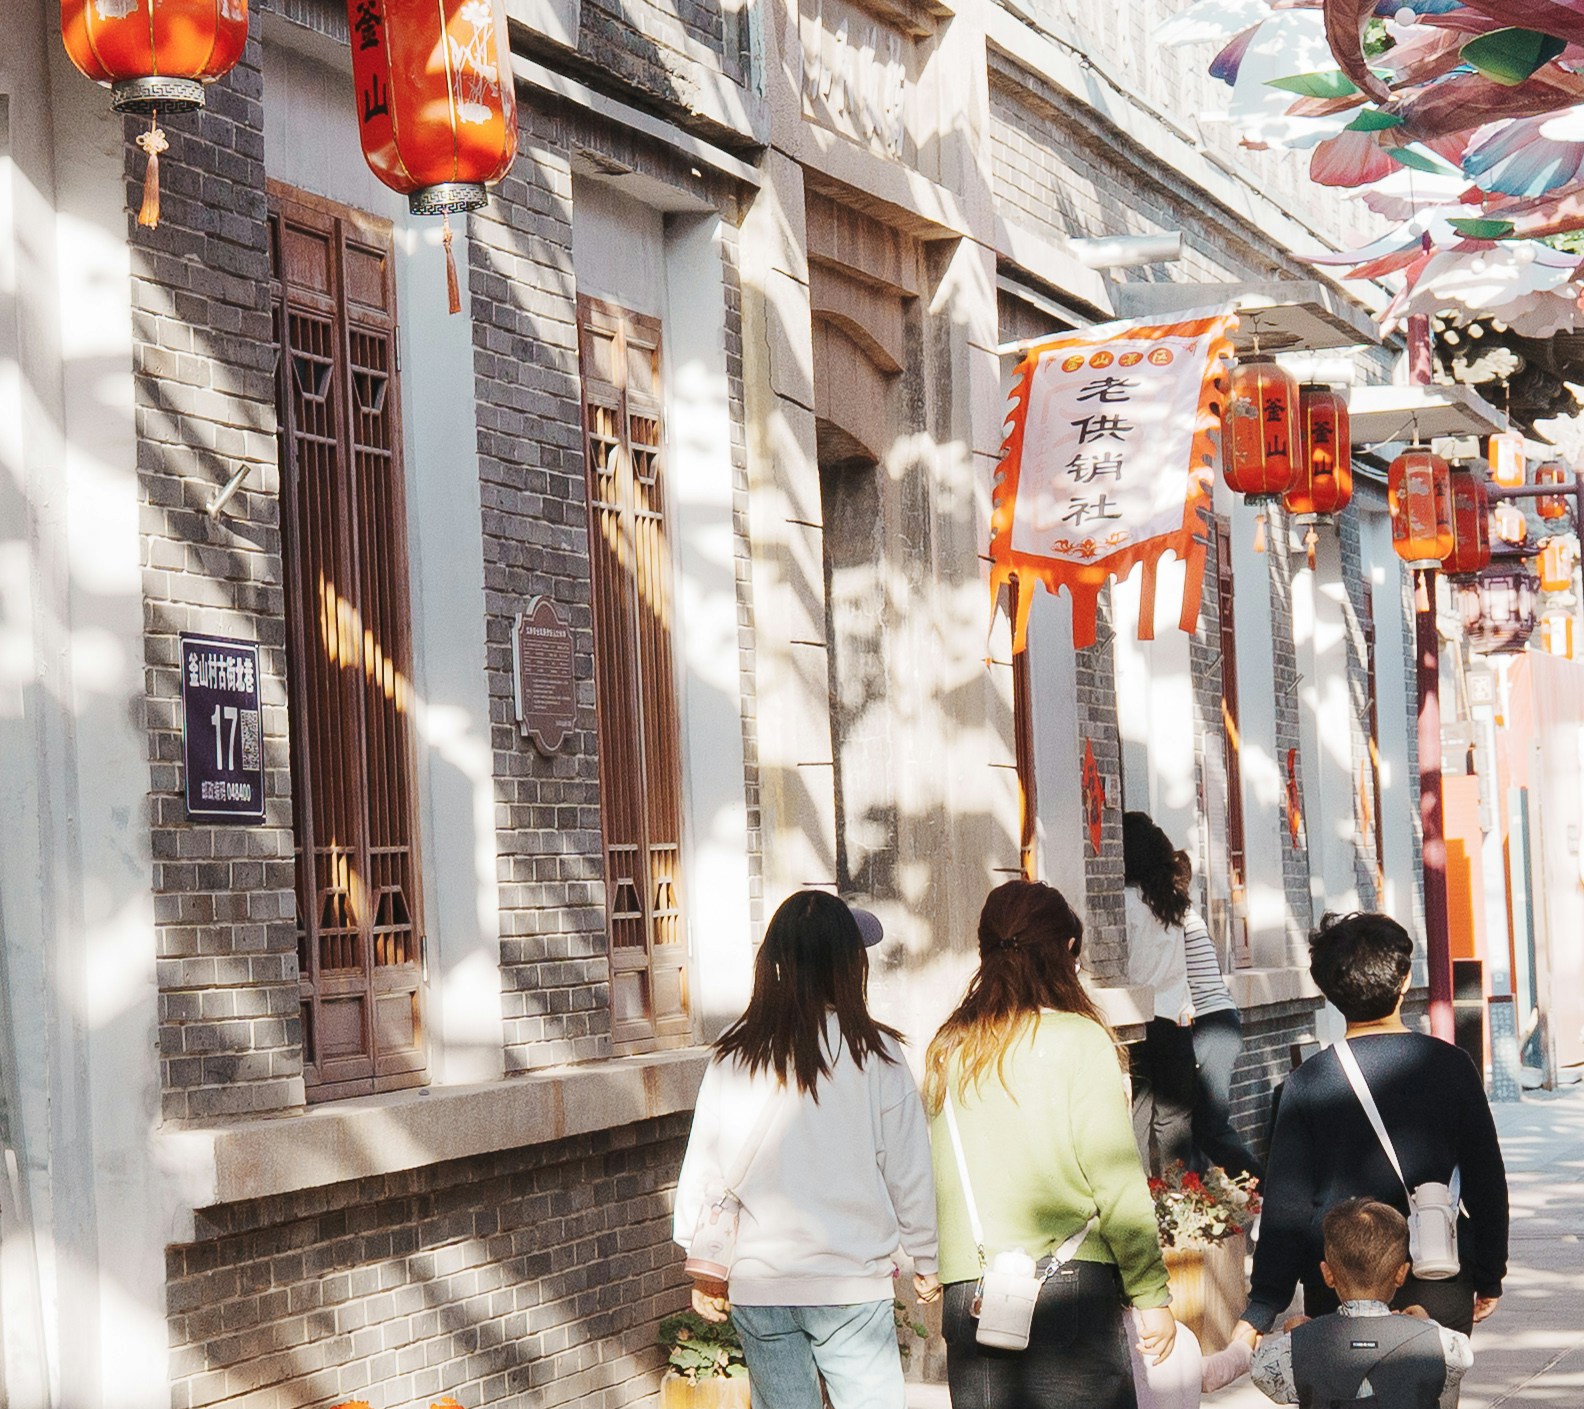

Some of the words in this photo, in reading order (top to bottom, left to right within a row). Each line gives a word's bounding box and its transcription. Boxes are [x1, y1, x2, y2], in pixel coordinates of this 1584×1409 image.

[354, 0, 389, 124] 釜山
[1061, 375, 1141, 528] 老供销社
[1263, 397, 1287, 458] 釜山
[1311, 420, 1334, 477] 釜山
[188, 652, 255, 694] 釜山村古街北巷
[210, 703, 239, 772] 17
